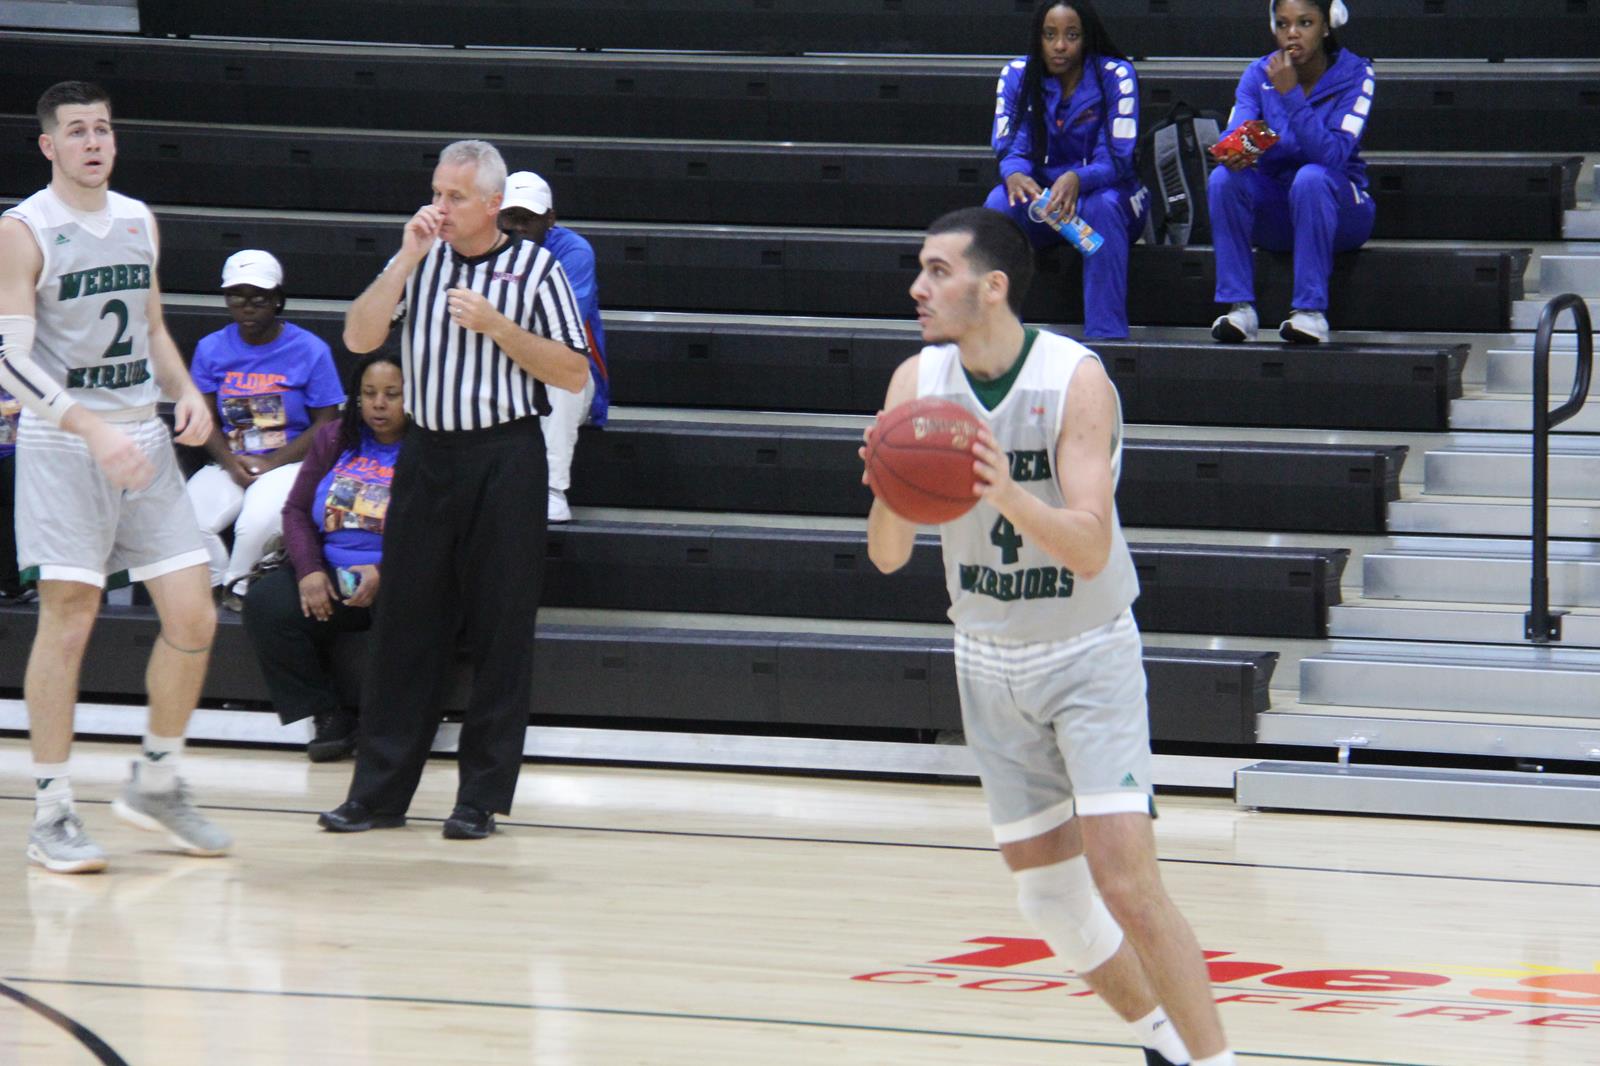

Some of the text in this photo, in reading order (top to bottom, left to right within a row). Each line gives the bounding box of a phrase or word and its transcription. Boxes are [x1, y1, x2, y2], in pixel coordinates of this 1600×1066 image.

[100, 299, 133, 359] 2
[990, 512, 1023, 565] 4
[959, 563, 1075, 601] WARRIORS
